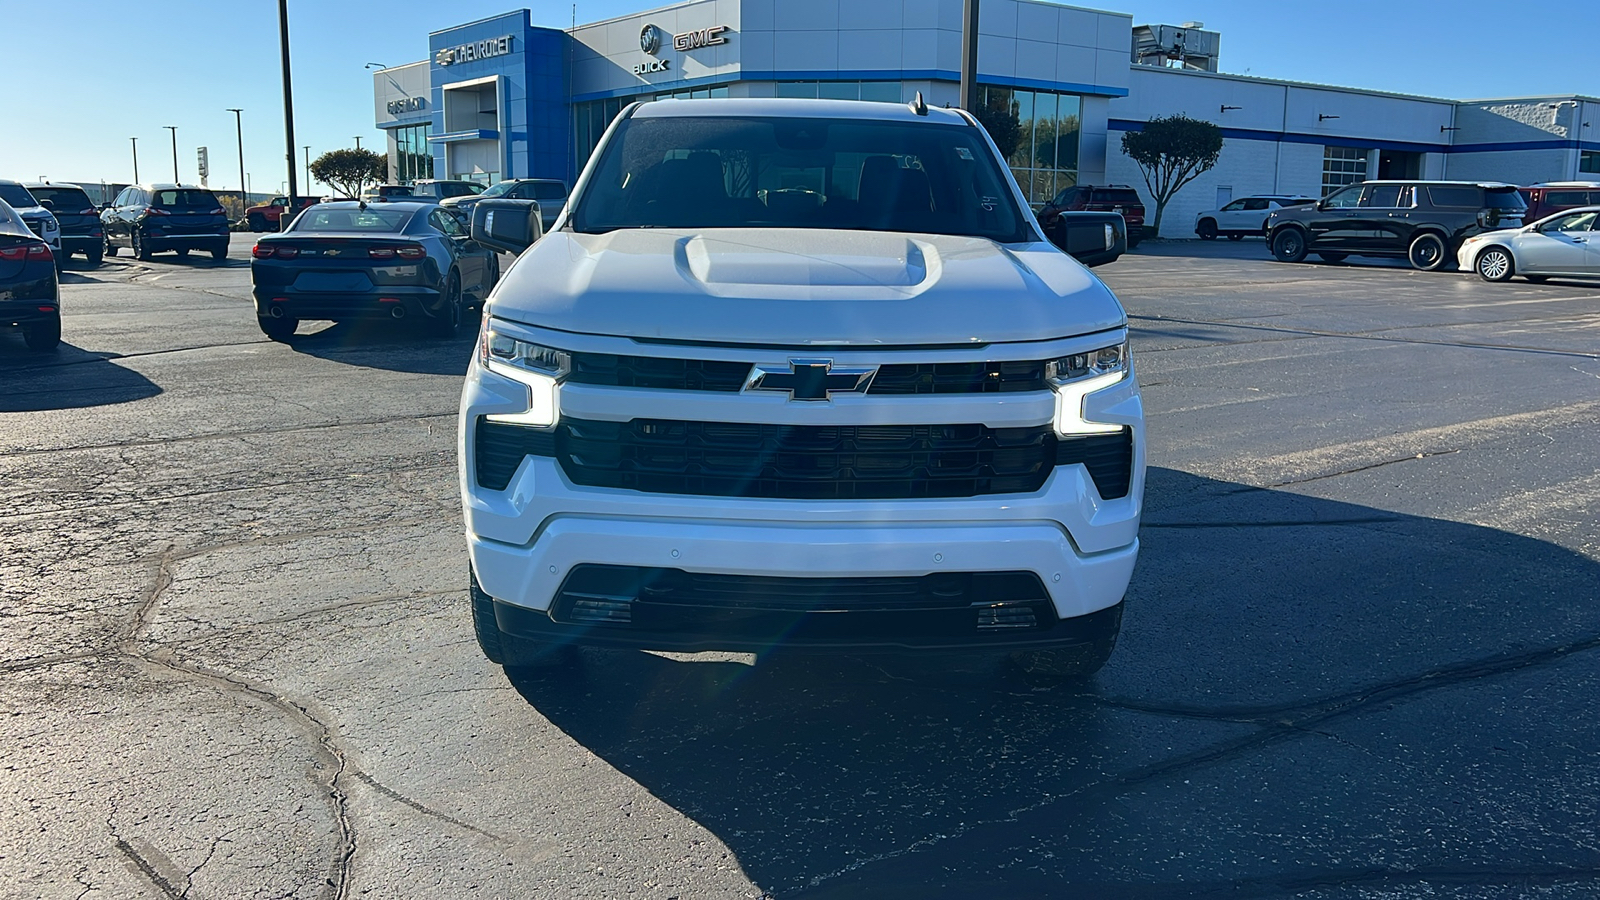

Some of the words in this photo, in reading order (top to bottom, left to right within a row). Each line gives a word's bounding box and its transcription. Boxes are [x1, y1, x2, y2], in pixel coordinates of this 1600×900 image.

[454, 35, 514, 64] CHEVROLET
[673, 26, 725, 51] GMC
[634, 60, 667, 75] BUICK
